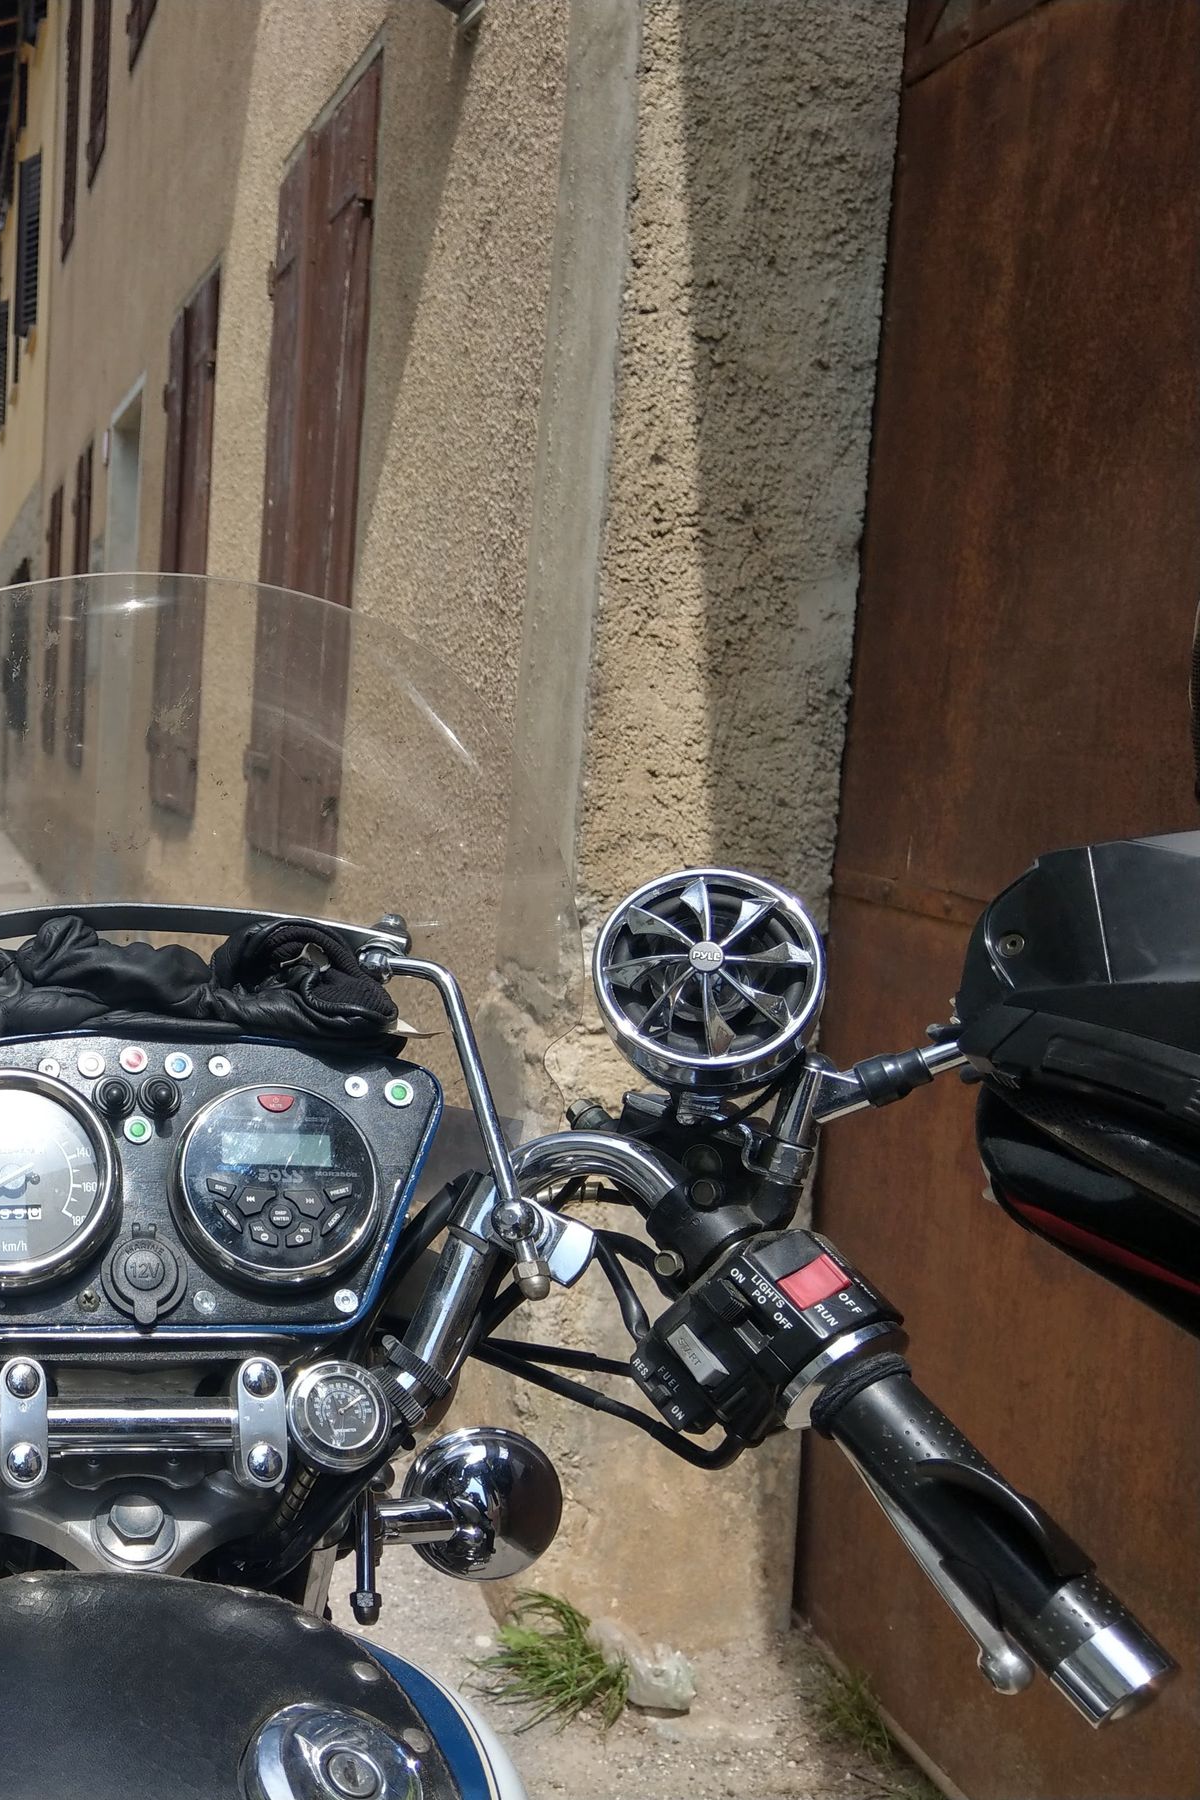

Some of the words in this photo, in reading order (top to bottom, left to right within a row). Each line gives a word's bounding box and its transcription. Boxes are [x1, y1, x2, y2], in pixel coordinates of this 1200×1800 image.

[692, 950, 721, 962] PYLE
[81, 1181, 97, 1192] 160
[214, 1184, 227, 1192] SRC
[329, 1186, 350, 1196] PRESET
[327, 1212, 341, 1228] AUDIO
[2, 1240, 28, 1252] km/h
[130, 1262, 160, 1279] 12V
[730, 1268, 746, 1284] ON
[751, 1289, 767, 1305] PO
[773, 1311, 794, 1330] OFF
[750, 1274, 785, 1309] LIGHTS
[838, 1292, 863, 1314] OFF
[814, 1303, 839, 1327] RUN
[677, 1337, 702, 1366] START
[632, 1357, 649, 1378] RES.
[657, 1365, 680, 1393] FUEL
[671, 1405, 686, 1421] ON
